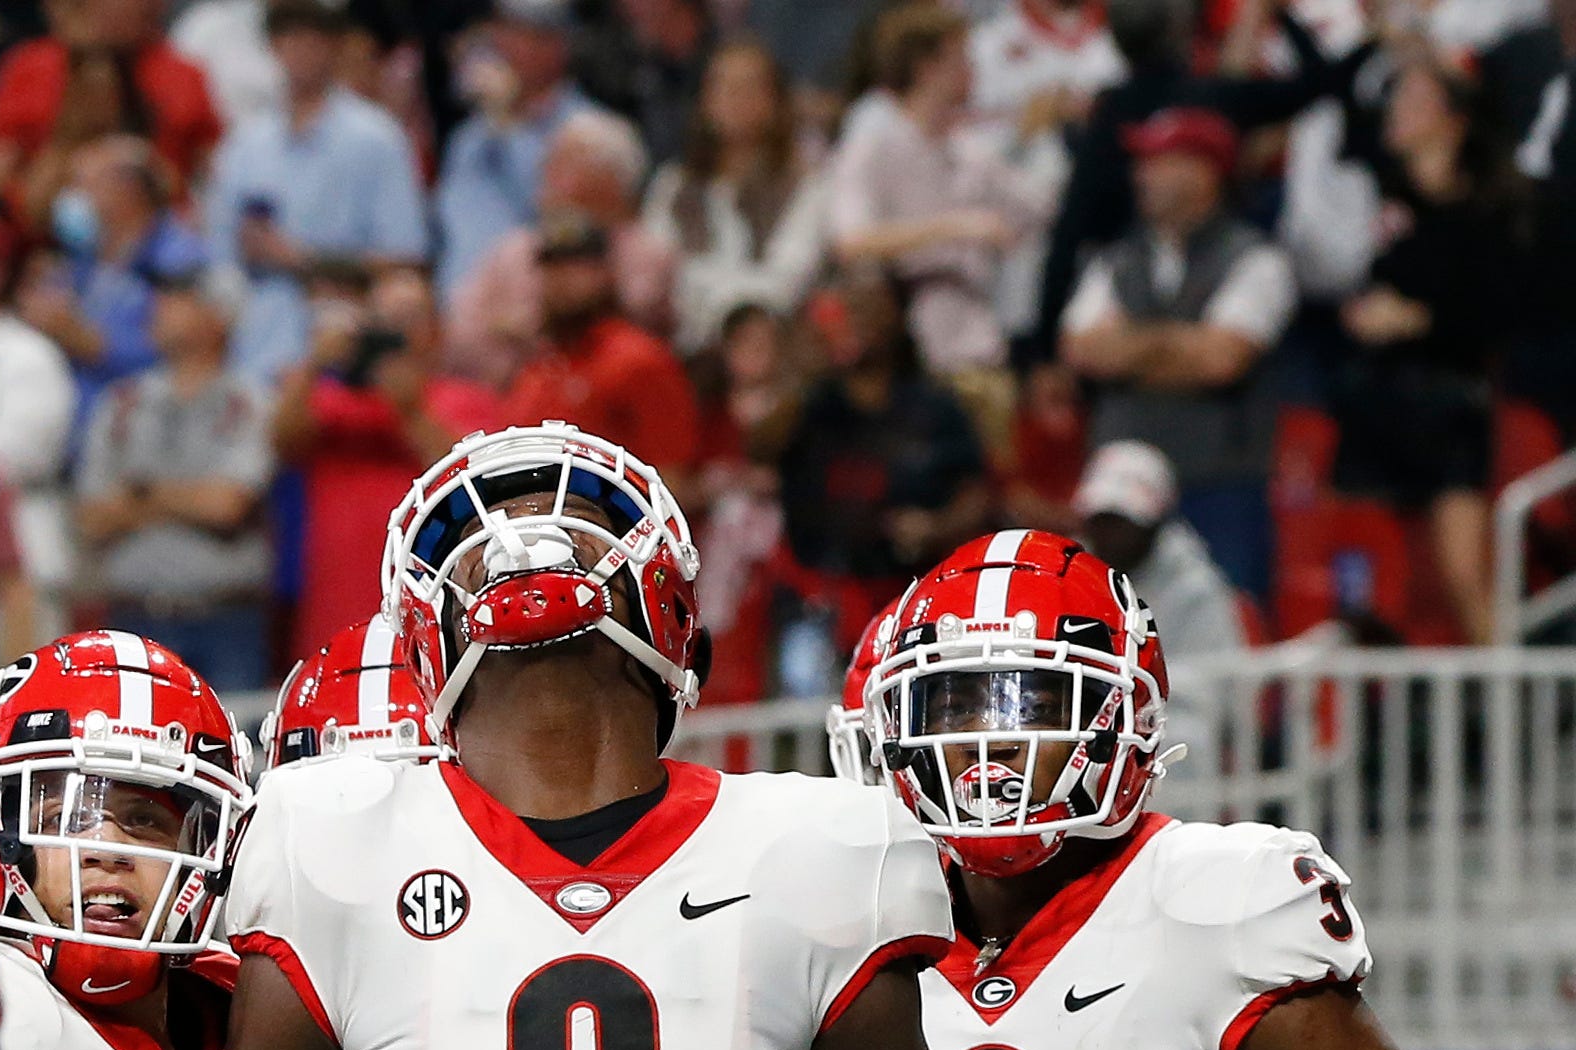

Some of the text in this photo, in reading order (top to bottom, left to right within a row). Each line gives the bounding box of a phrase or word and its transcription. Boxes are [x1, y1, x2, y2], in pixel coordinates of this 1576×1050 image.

[112, 725, 158, 740] DAWGS
[348, 729, 393, 741] DAWGS
[399, 871, 468, 938] SEC
[557, 883, 611, 914] G
[1292, 855, 1353, 942] 3
[974, 977, 1015, 1007] G
